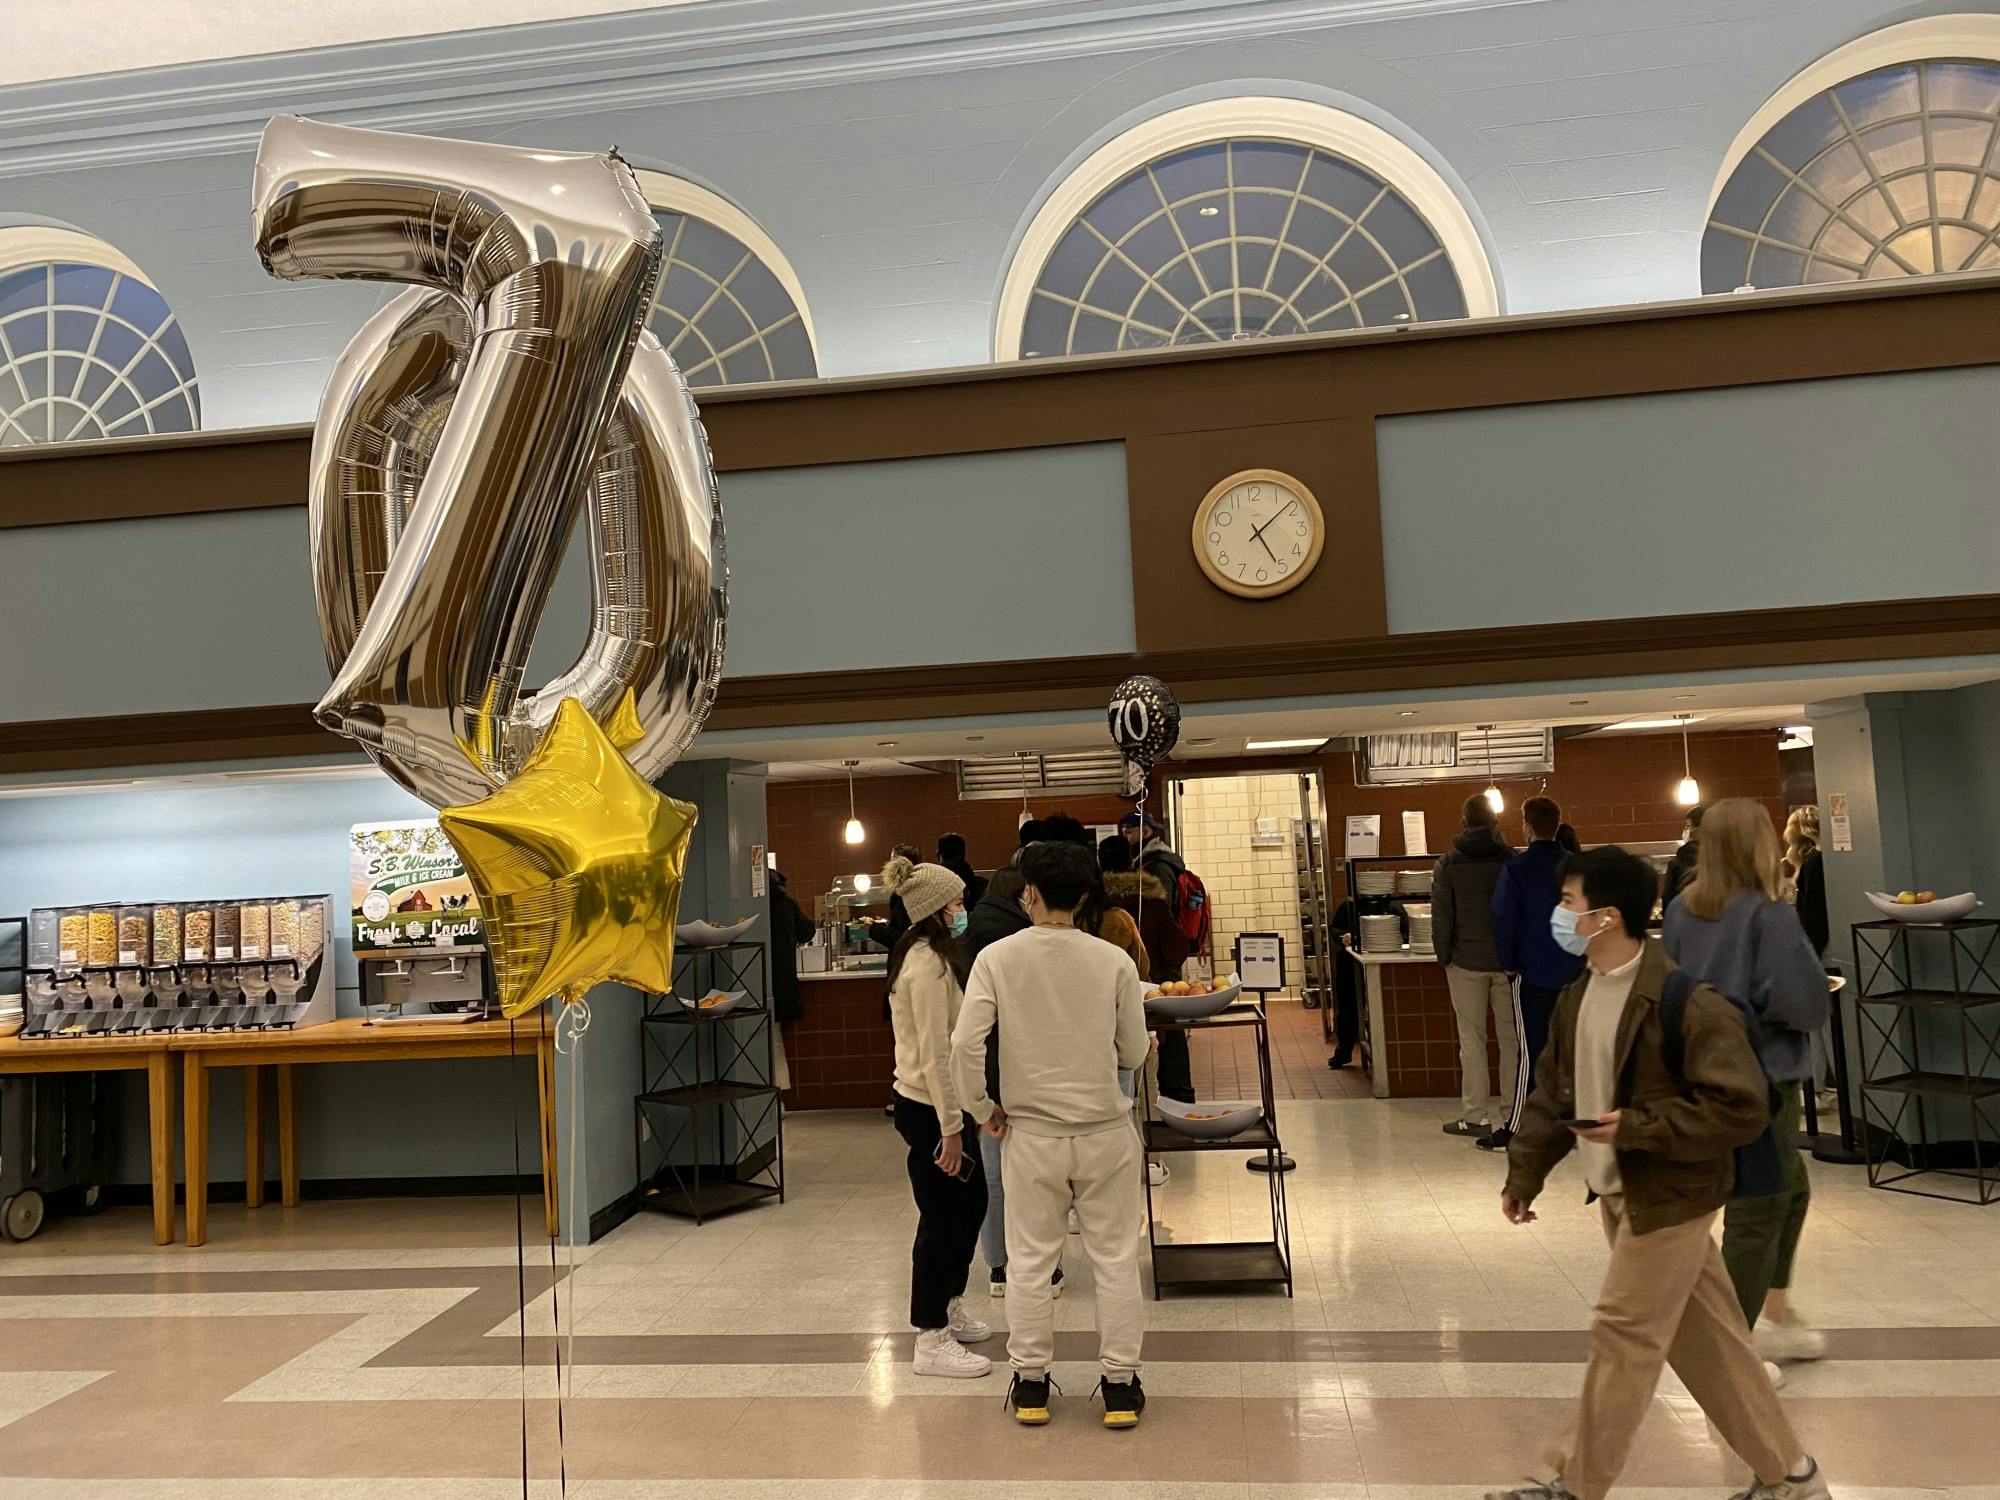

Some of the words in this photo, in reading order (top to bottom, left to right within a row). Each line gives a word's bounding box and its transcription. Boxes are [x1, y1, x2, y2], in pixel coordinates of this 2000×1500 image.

[1230, 494, 1240, 510] 11
[1247, 485, 1261, 502] 12
[1274, 487, 1279, 505] 1
[1288, 500, 1299, 517] 2
[1214, 511, 1233, 527] 10
[1295, 520, 1308, 537] 3
[1209, 531, 1221, 547] 9
[1217, 550, 1230, 567] 8
[1291, 542, 1302, 558] 4
[1236, 562, 1247, 579] 7
[1255, 565, 1268, 582] 6
[1277, 558, 1289, 575] 5
[1108, 696, 1149, 744] 70
[401, 853, 462, 871] Winsor's
[394, 874, 411, 888] MILK
[412, 872, 418, 883] &
[419, 871, 430, 881] ICE
[430, 869, 454, 880] CREAM
[428, 917, 479, 939] Local
